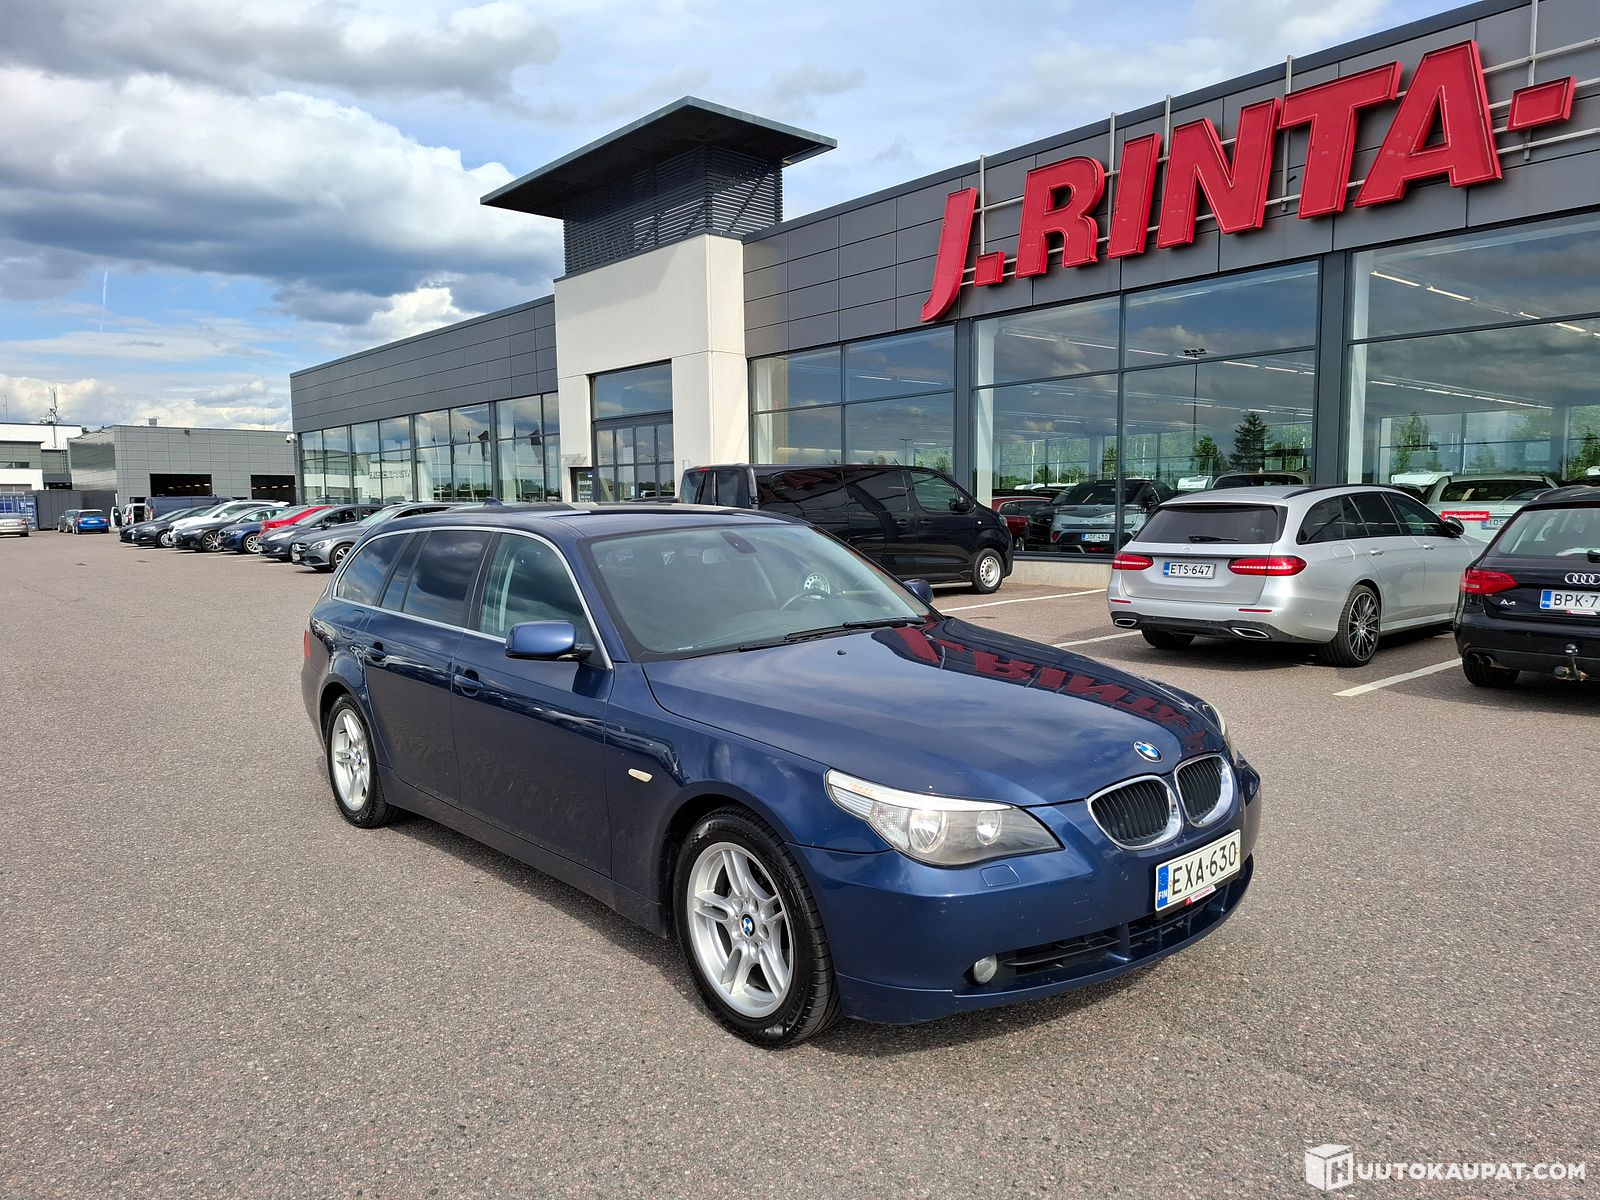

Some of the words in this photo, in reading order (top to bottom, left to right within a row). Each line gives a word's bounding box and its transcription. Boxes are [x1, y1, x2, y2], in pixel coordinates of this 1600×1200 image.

[1171, 565, 1212, 575] ETS-647
[1171, 840, 1238, 896] EXA-630
[1158, 889, 1168, 900] FIN
